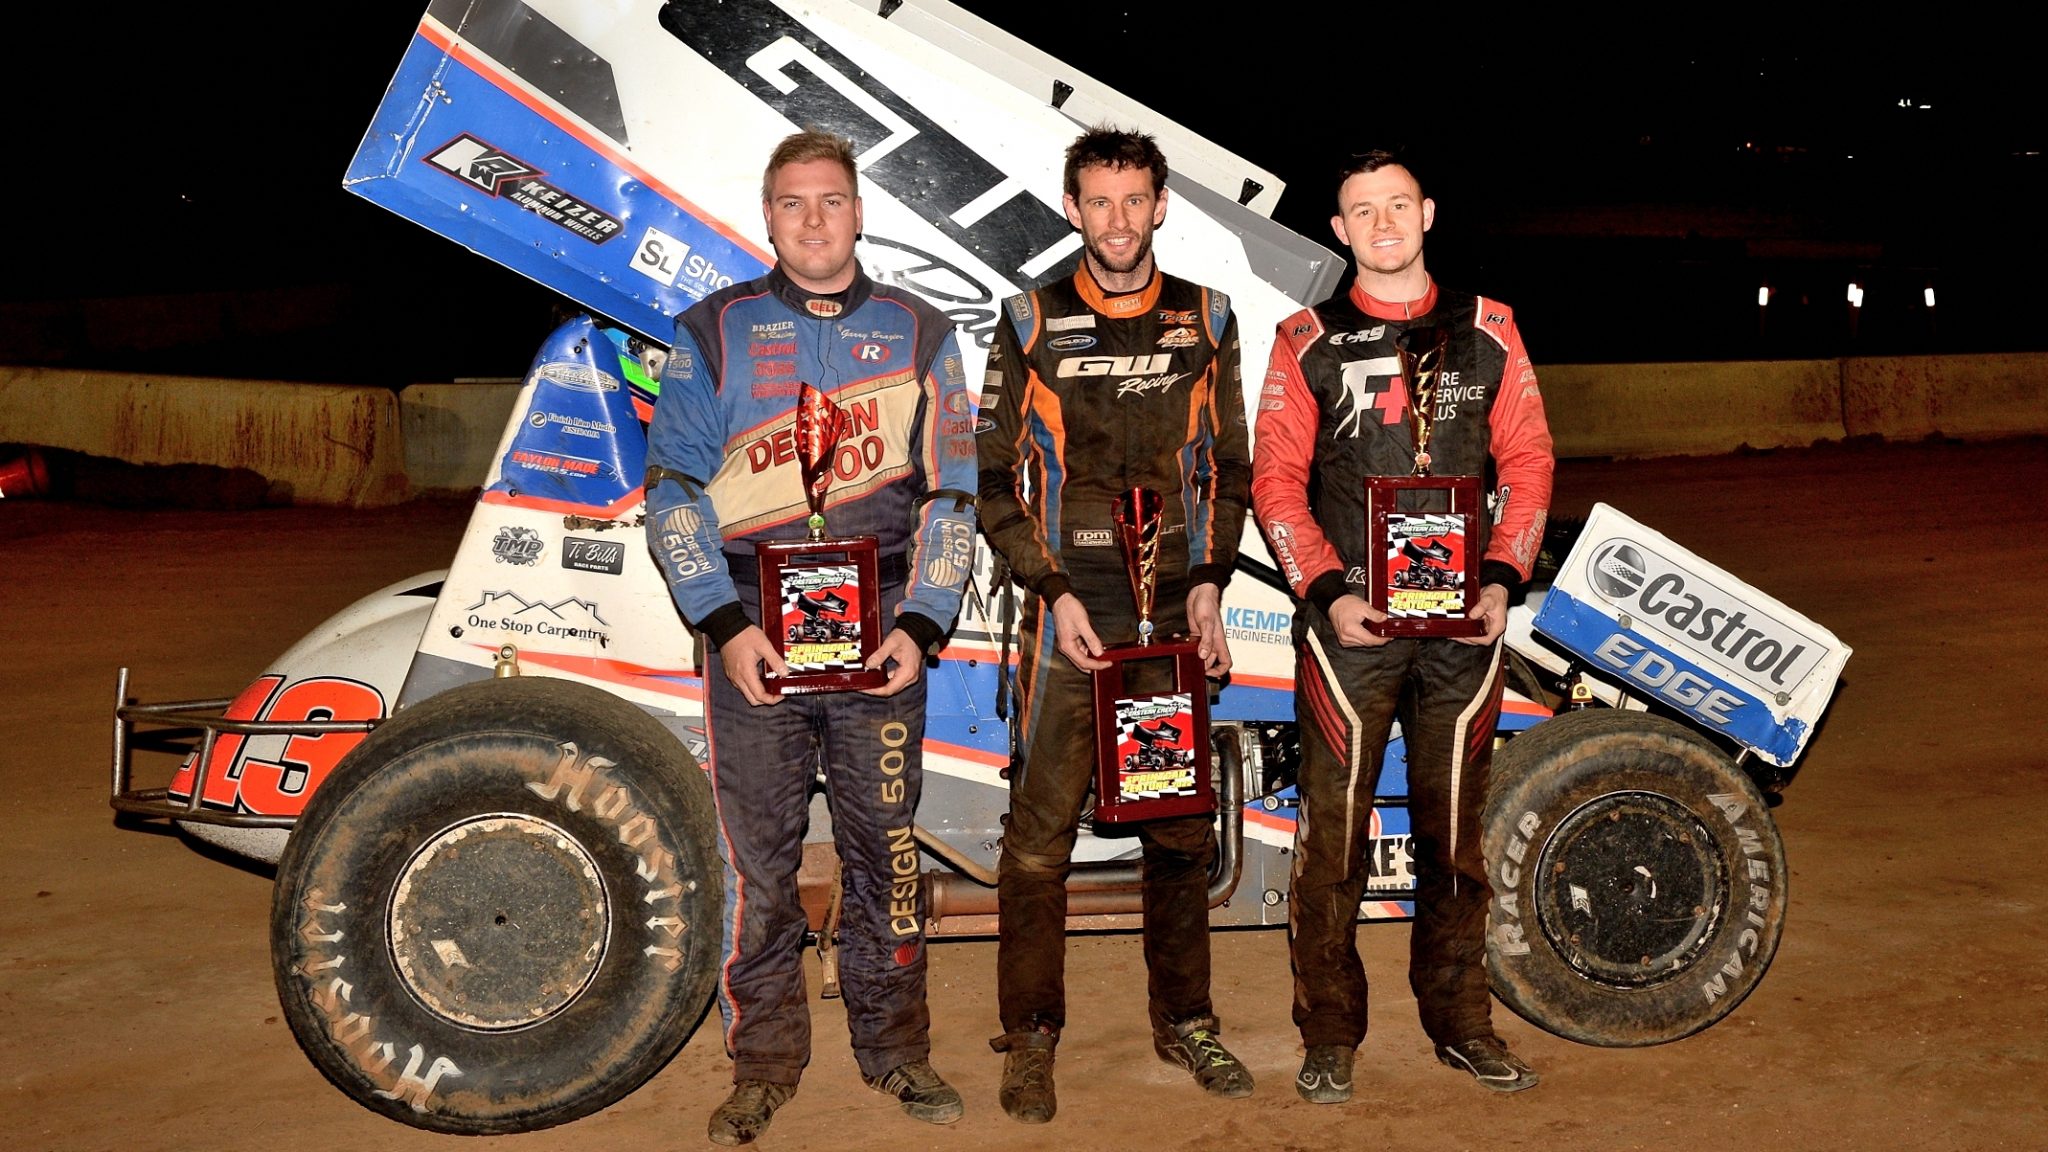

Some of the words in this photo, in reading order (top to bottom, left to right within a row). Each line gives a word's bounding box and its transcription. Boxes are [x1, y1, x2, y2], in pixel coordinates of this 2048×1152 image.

[511, 192, 560, 221] ALUMINUM
[563, 218, 603, 241] WHEELS
[521, 181, 618, 234] KEIZER
[640, 239, 672, 275] SL
[684, 254, 734, 290] Sho
[811, 301, 837, 313] BELL
[1111, 297, 1140, 309] rpm
[752, 321, 795, 332] BRAZIER
[861, 345, 881, 360] R
[1056, 353, 1172, 378] GW
[1117, 371, 1192, 399] Racing
[1440, 372, 1460, 386] RE
[1436, 386, 1485, 403] ERVICE
[548, 412, 573, 425] Finish
[591, 420, 617, 433] Media
[560, 425, 600, 439] AUSTRALIA
[511, 450, 560, 468] TAYLOR
[561, 460, 601, 475] MADE
[492, 535, 544, 556] TMP
[941, 521, 954, 562] DESIGN
[952, 523, 971, 570] 500
[1076, 531, 1110, 540] rpm
[568, 541, 585, 559] Ti
[585, 543, 618, 564] Bills
[662, 533, 698, 576] 500
[682, 535, 713, 572] DESIGN
[589, 563, 609, 571] PARTS
[1391, 600, 1438, 610] FEATURE
[1393, 591, 1456, 601] SPRINTCAR
[467, 614, 497, 628] One
[500, 618, 533, 635] Stop
[1226, 606, 1291, 632] KEMP
[1637, 573, 1806, 686] Castrol
[1225, 628, 1293, 646] ENGINEERIN
[787, 652, 836, 665] FEATURE
[1593, 633, 1749, 725] EDGE
[880, 721, 908, 805] 500
[1124, 780, 1170, 793] FEATURE
[1125, 770, 1187, 784] SPRINTCAR
[1369, 837, 1416, 878] KE'S
[886, 825, 920, 936] DESIGN
[1499, 810, 1543, 957] RACER
[1705, 792, 1771, 1005] AMERICAN
